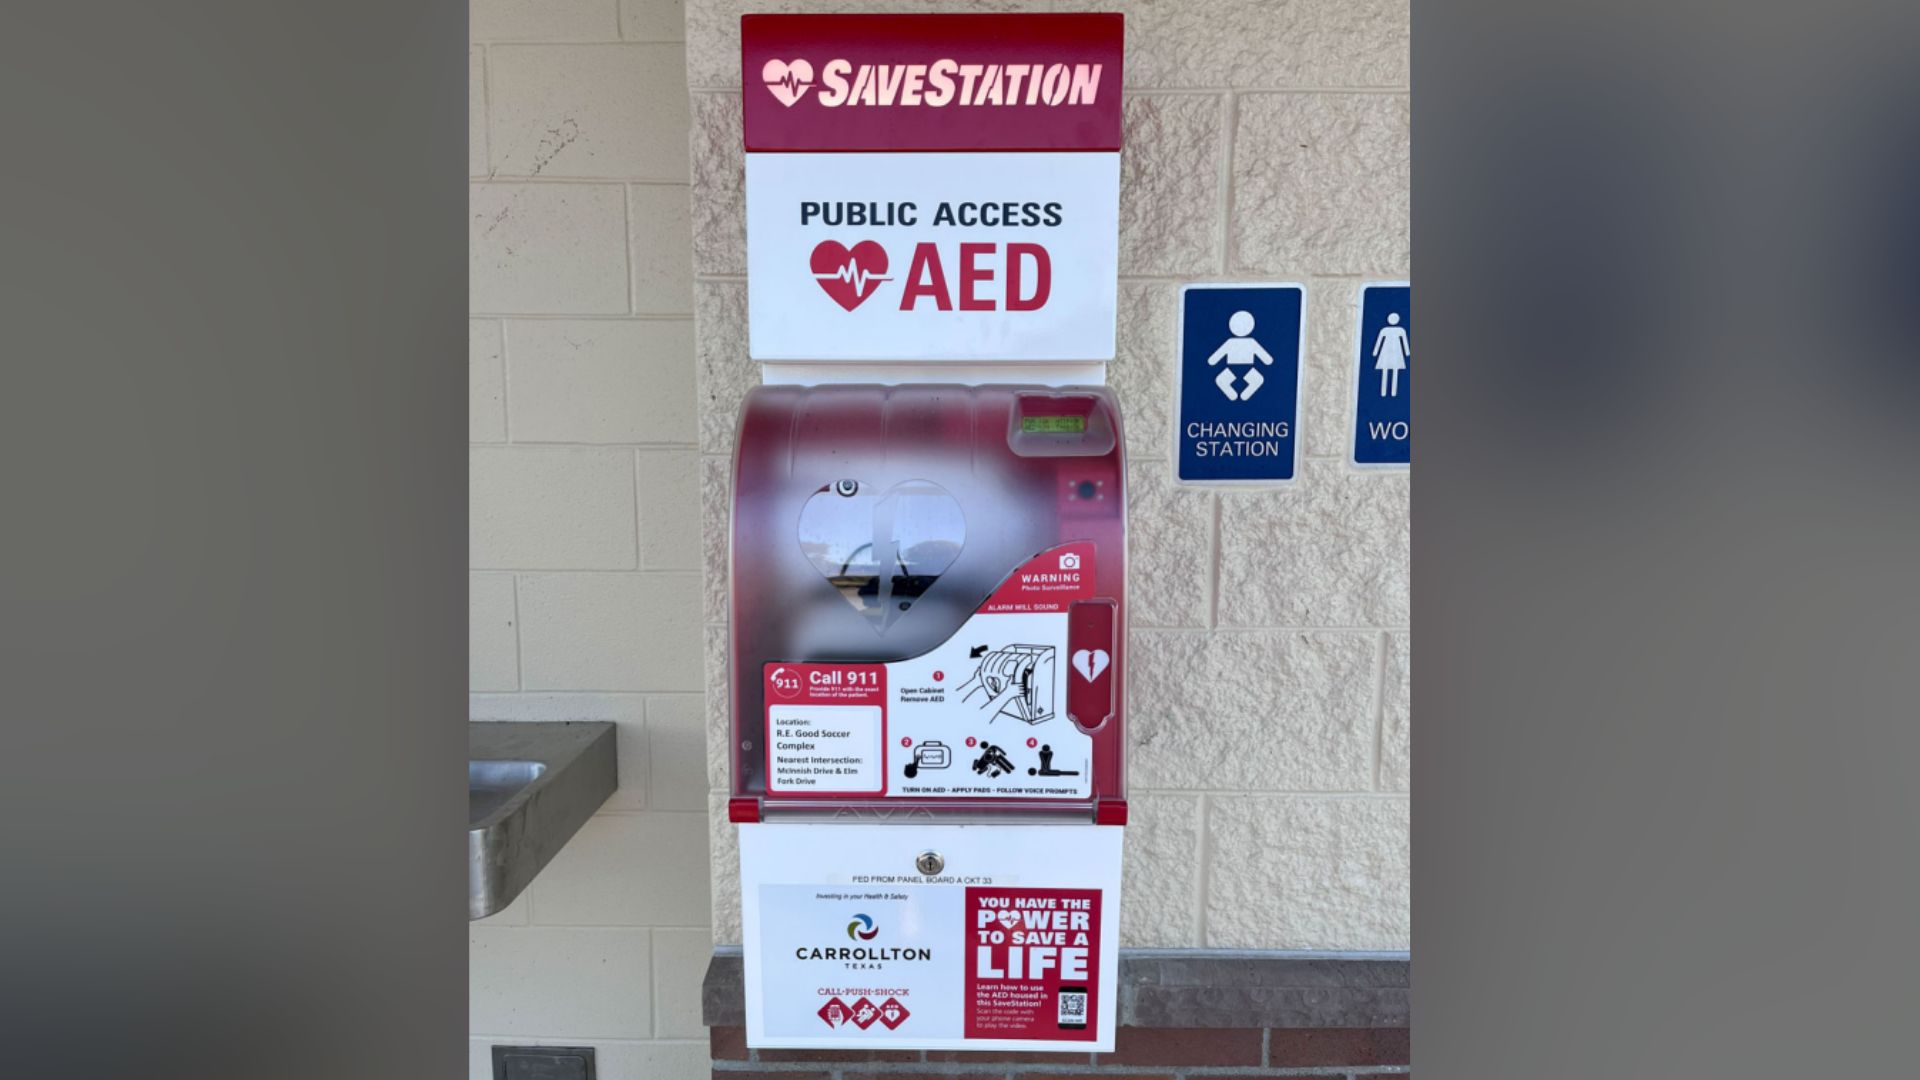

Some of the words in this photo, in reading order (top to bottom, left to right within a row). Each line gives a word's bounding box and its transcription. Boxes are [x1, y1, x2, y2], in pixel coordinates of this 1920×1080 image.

[800, 201, 917, 226] PUBLIC
[932, 202, 1063, 227] ACCESS
[899, 242, 1052, 312] AED
[1187, 422, 1289, 438] CHANGING
[1195, 441, 1279, 457] STATION
[1021, 573, 1080, 583] WARNING
[776, 678, 799, 688] 911
[809, 670, 842, 685] Call
[847, 671, 877, 685] 911
[776, 718, 811, 726] Location:
[777, 729, 794, 738] R.E.
[795, 729, 820, 738] Good
[821, 729, 850, 738] Soccer
[777, 742, 815, 751] Complex
[813, 767, 834, 775] Drive
[835, 767, 842, 775] &
[844, 767, 858, 775] Elm
[898, 876, 923, 884] PANEL
[926, 876, 955, 885] BOARD
[982, 877, 993, 885] 33
[978, 897, 1010, 909] YOU
[1015, 898, 1057, 909] HAVE
[1061, 899, 1091, 910] THE
[978, 931, 1005, 944] TO
[1011, 932, 1067, 945] SAVE
[1073, 933, 1089, 946] A
[796, 947, 931, 960] CARROLLTON
[977, 945, 1089, 980] LIFE
